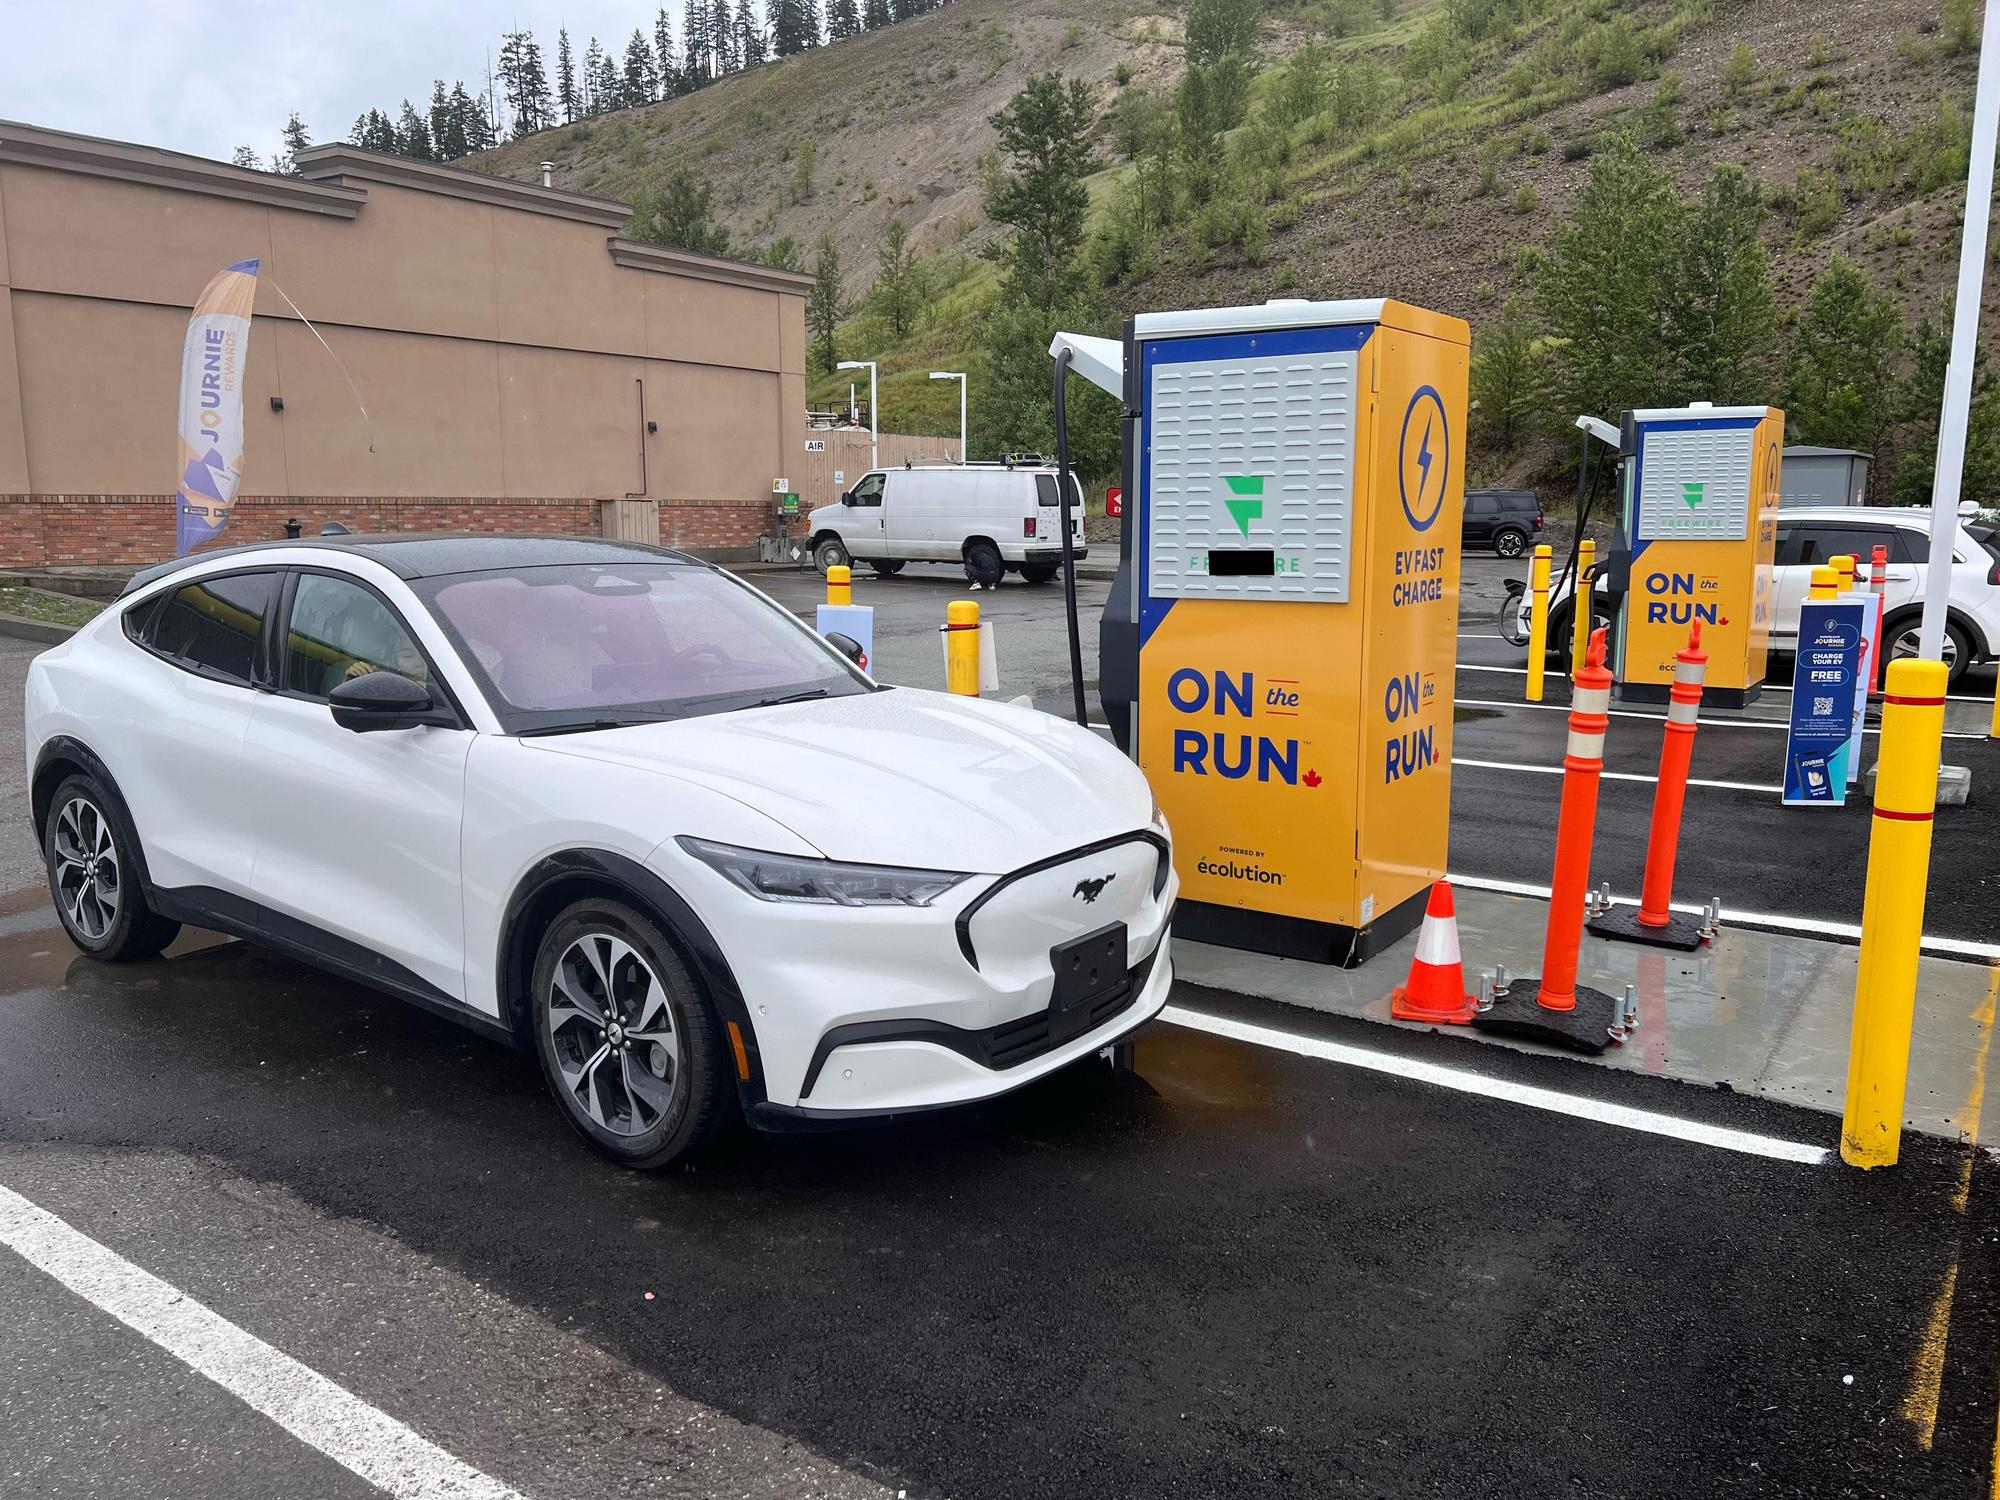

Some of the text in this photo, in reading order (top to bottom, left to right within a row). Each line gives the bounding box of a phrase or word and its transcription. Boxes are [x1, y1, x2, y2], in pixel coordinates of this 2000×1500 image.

[224, 330, 236, 392] REWARDS
[200, 328, 225, 443] JOURNIE
[807, 441, 824, 451] AIR
[1190, 556, 1300, 572] FRRE
[1395, 547, 1444, 575] EV FAST
[1393, 577, 1443, 607] CHARGE
[1645, 572, 1719, 595] ON the
[1647, 602, 1718, 625] RUN
[1810, 670, 1842, 680] FREE
[1167, 667, 1300, 718] ON the
[1385, 671, 1435, 723] ON the
[1174, 728, 1299, 785] RUN
[1385, 725, 1433, 784] RUN
[1219, 846, 1254, 856] POWERED
[1197, 856, 1282, 885] écolution
